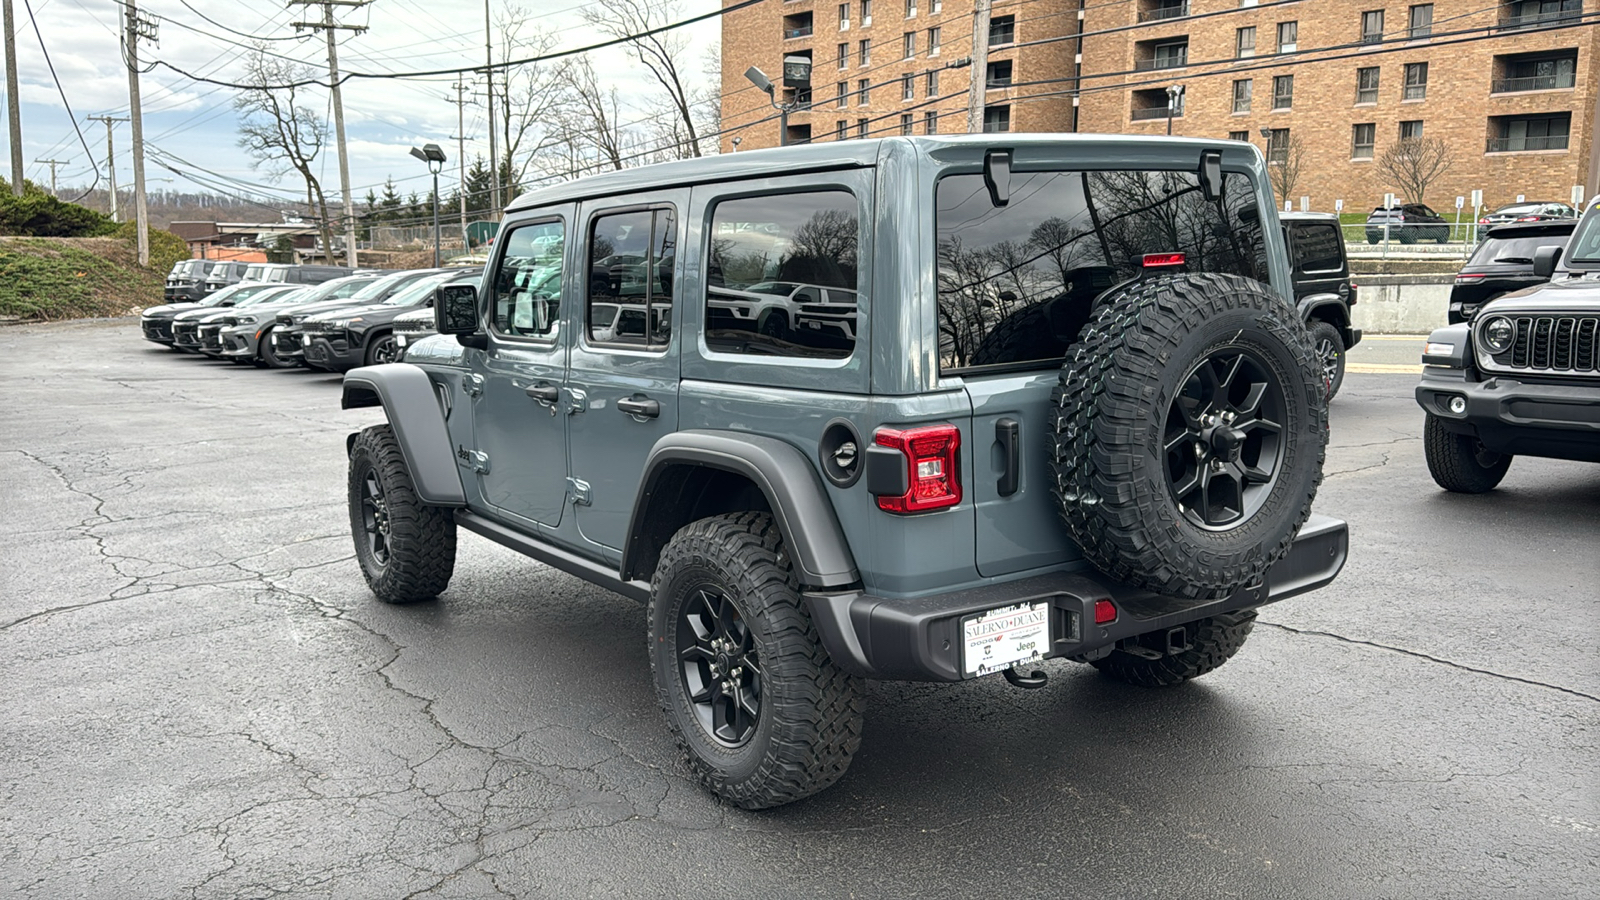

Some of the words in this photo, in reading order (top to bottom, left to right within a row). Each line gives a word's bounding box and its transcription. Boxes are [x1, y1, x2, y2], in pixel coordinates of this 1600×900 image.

[965, 620, 1009, 638] SALERNO
[1013, 611, 1045, 627] DUANE
[1016, 641, 1036, 652] Jeep
[975, 662, 1010, 677] SALERNO
[1020, 654, 1044, 666] DUANE
